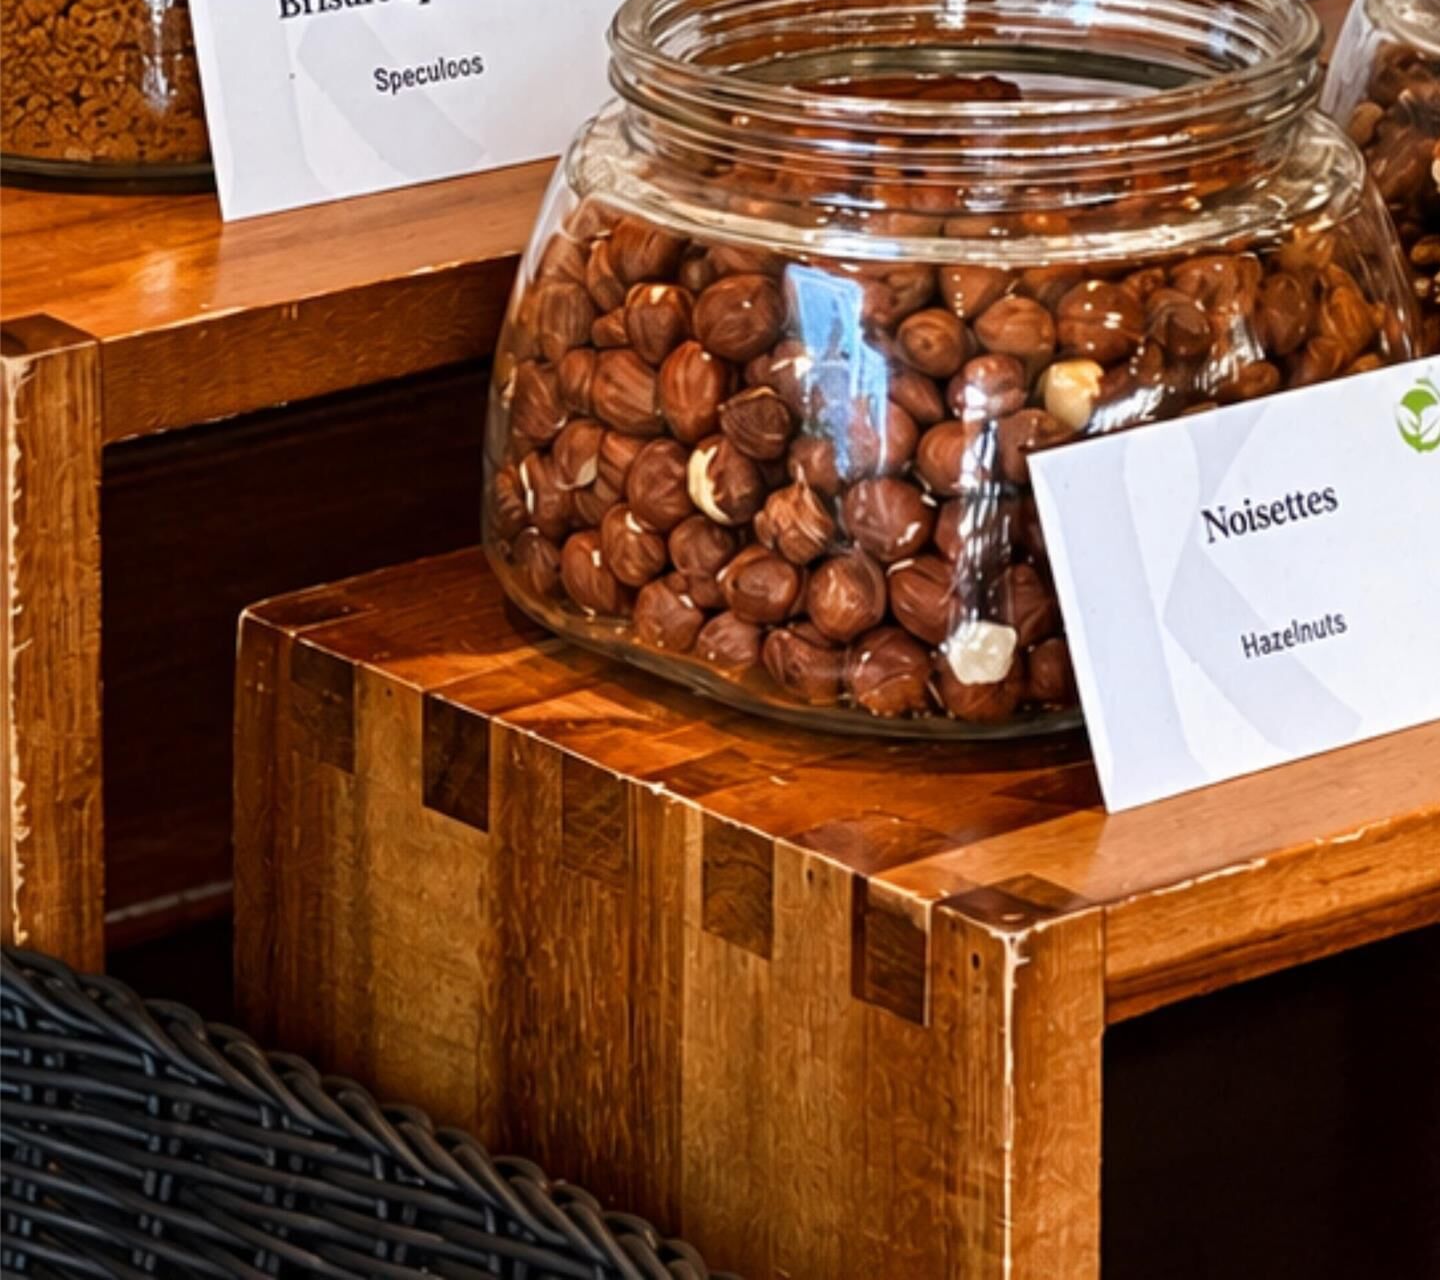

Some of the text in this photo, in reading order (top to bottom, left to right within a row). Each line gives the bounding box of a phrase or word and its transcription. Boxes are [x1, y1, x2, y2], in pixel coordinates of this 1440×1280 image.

[372, 53, 485, 96] Speculoos
[1200, 484, 1340, 546] Noisettes
[1239, 610, 1350, 660] Hazelnuts
